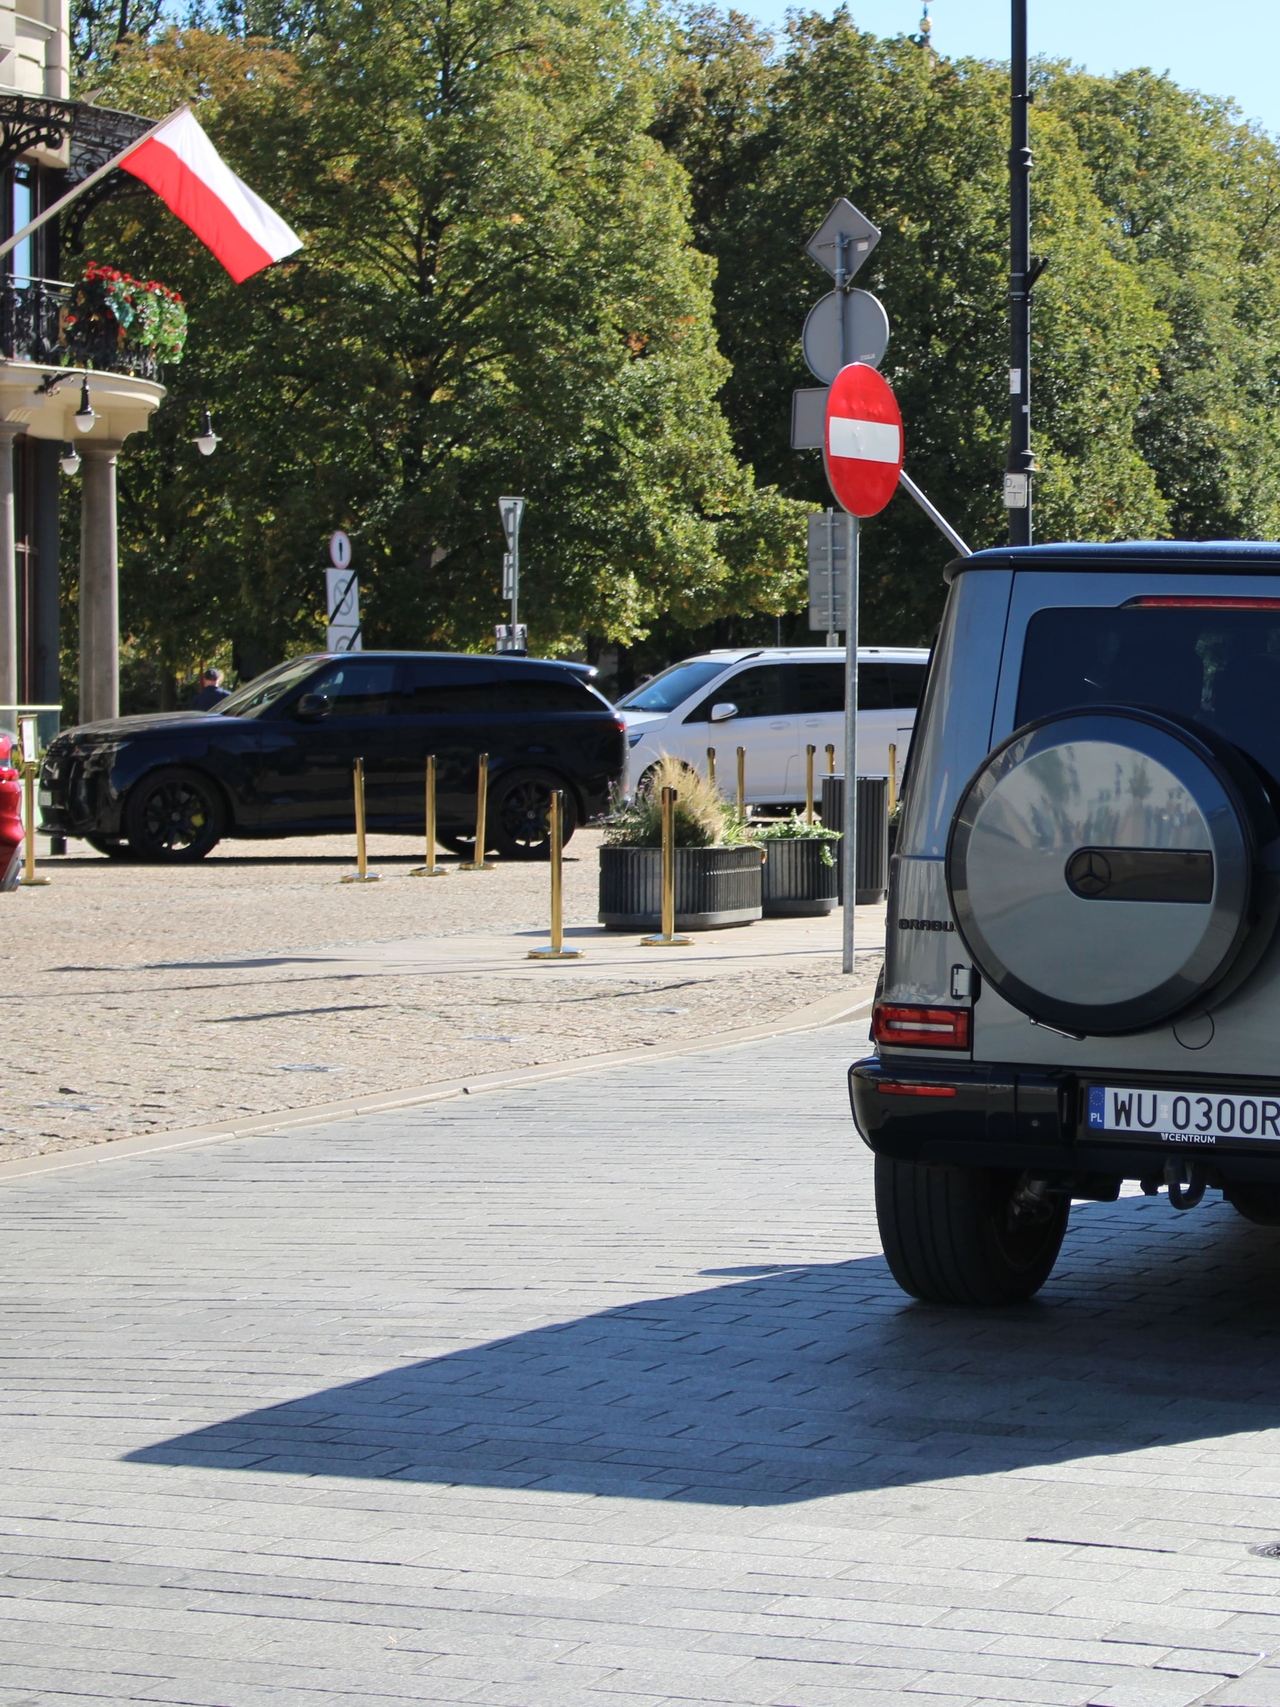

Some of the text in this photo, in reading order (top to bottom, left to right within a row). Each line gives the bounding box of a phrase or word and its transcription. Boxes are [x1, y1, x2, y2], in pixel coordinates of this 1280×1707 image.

[899, 918, 957, 932] BRABU
[1090, 1112, 1102, 1123] PL
[1113, 1092, 1157, 1128] WU
